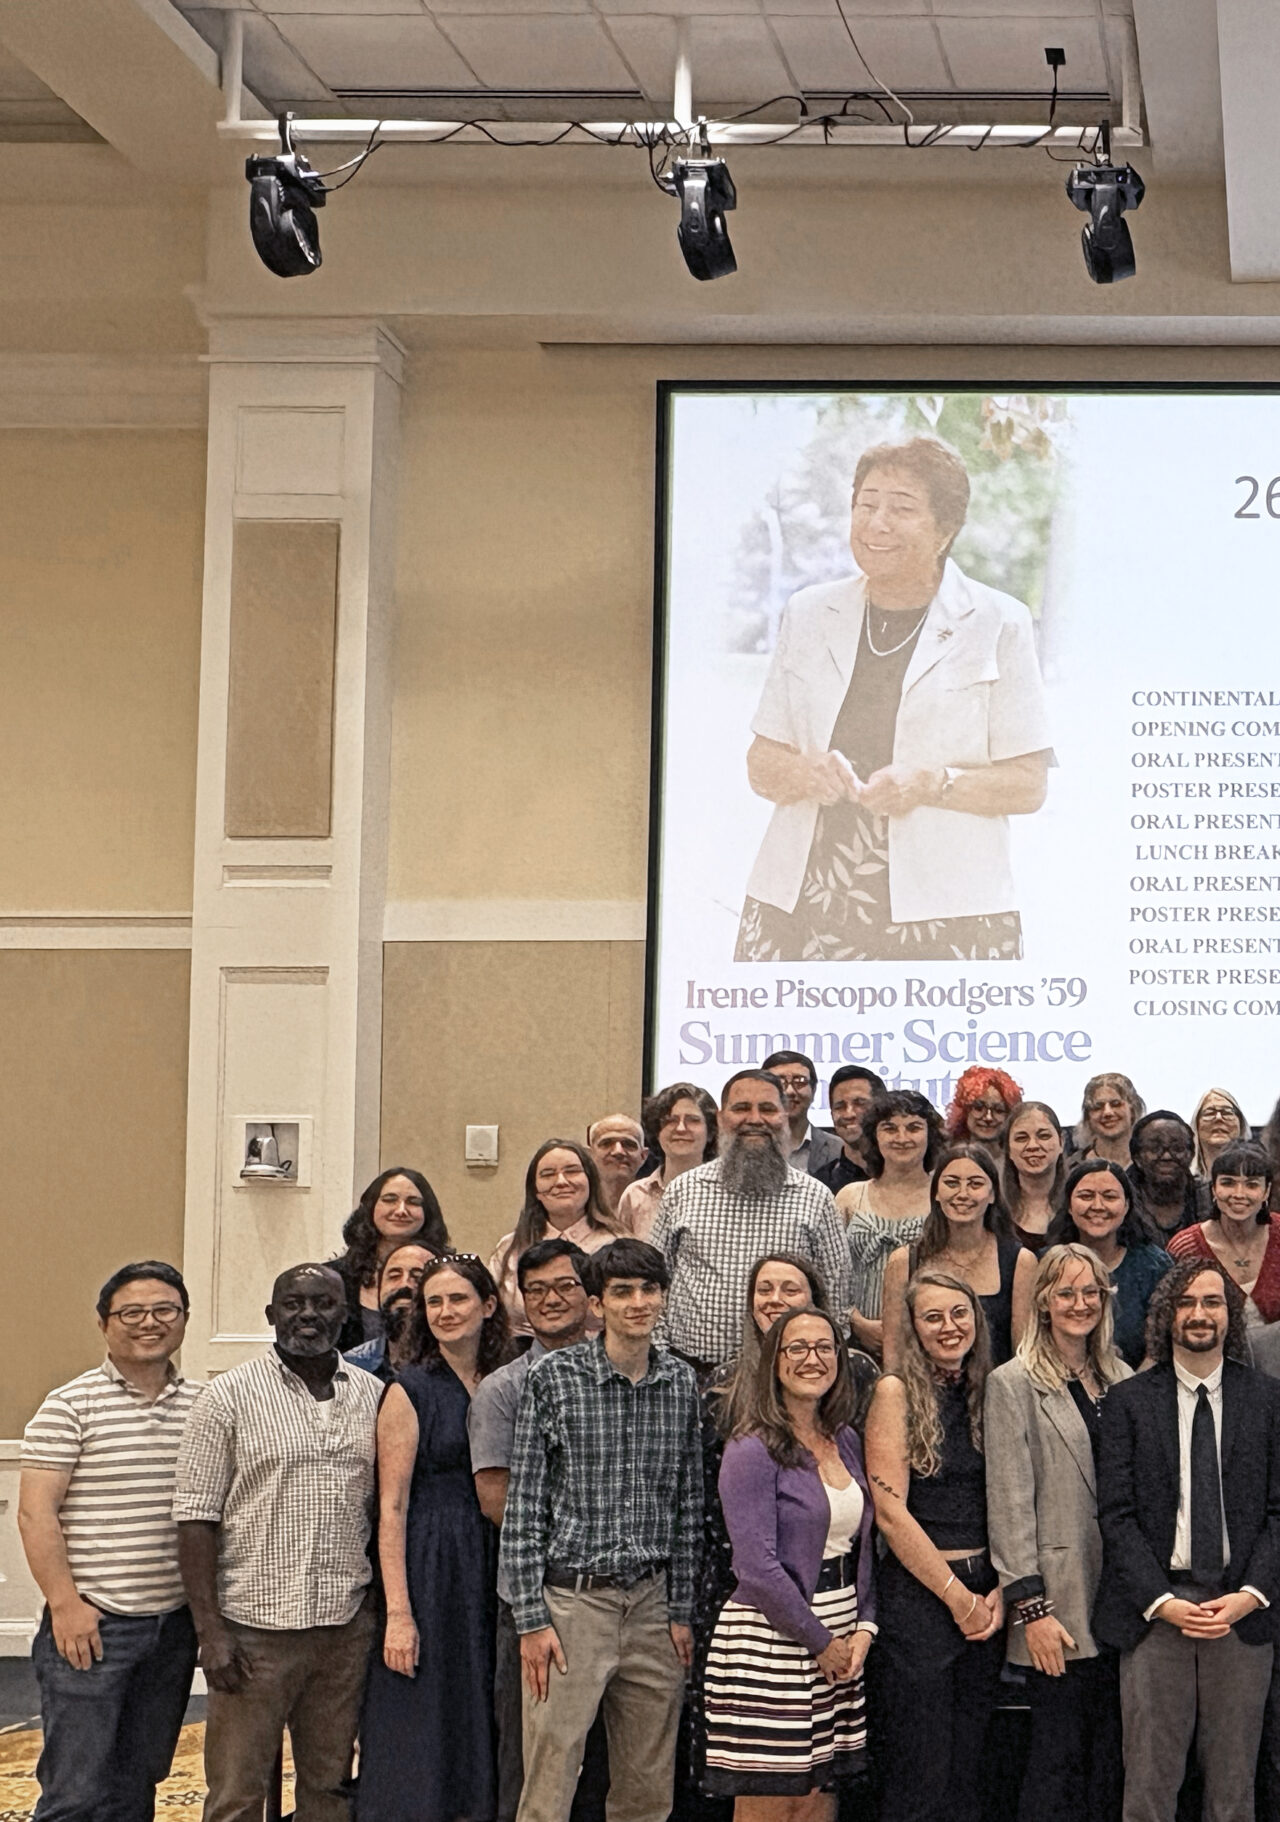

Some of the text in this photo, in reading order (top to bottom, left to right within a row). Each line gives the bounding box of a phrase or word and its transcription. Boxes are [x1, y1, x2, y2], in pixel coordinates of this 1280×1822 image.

[1131, 720, 1226, 737] OPENING
[1130, 751, 1190, 768] ORAL
[1129, 782, 1211, 799] POSTER
[1130, 813, 1190, 830] ORAL
[1135, 844, 1209, 861] LUNCH
[1130, 875, 1190, 892] ORAL
[1129, 906, 1211, 923] POSTER
[1130, 937, 1190, 954] ORAL
[1129, 968, 1211, 985] POSTER
[686, 980, 769, 1009] Irene
[774, 979, 898, 1015] Piscopo
[903, 977, 1035, 1015] Rodgers
[1133, 999, 1228, 1016] CLOSING
[679, 1018, 1092, 1065] Summer Science
